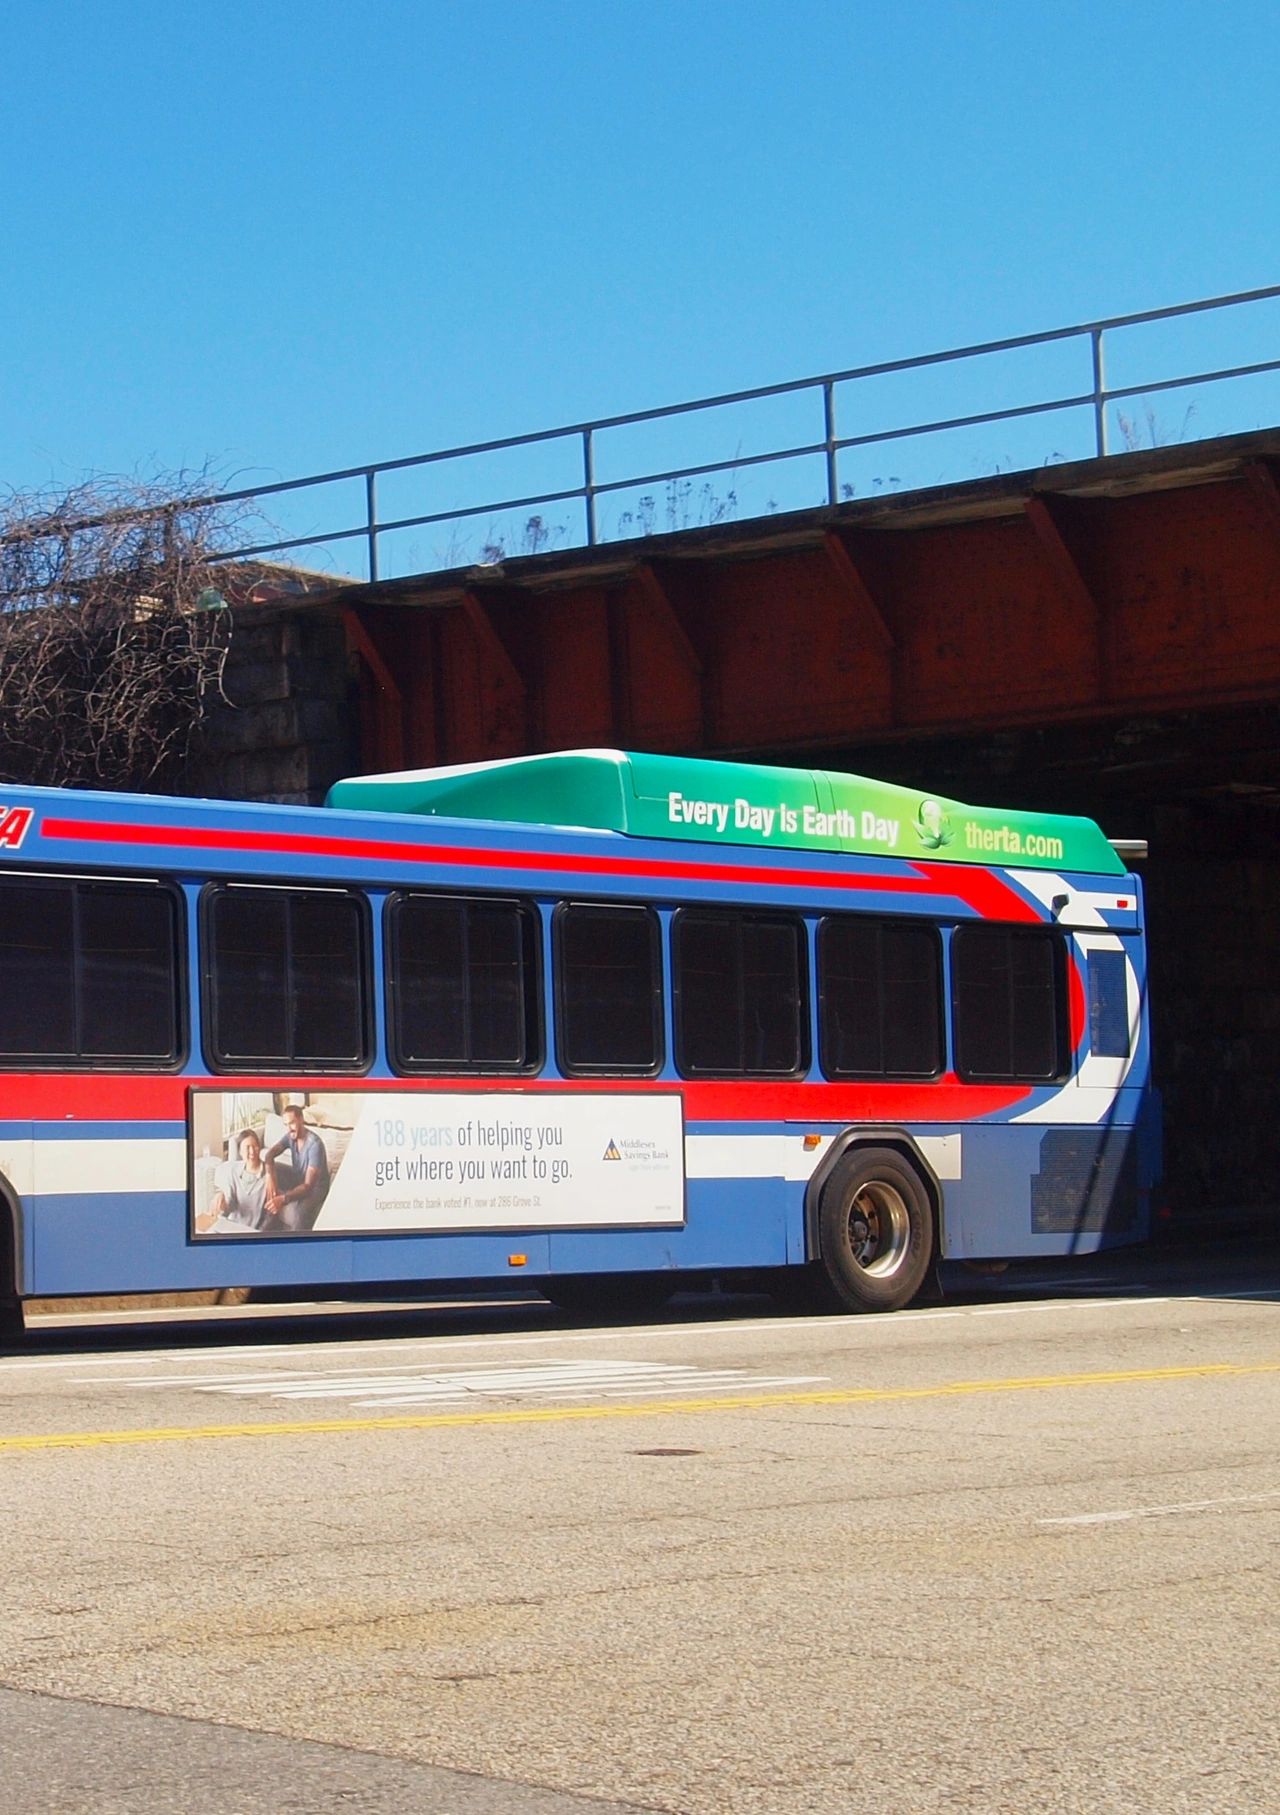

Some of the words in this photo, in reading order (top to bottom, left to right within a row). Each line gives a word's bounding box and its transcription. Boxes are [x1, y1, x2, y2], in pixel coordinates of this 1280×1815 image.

[669, 792, 729, 833] Every
[735, 798, 775, 837] Day
[803, 805, 856, 839] Earth
[861, 810, 899, 847] Day
[964, 822, 1063, 860] therta.com
[374, 1119, 405, 1147] 188
[410, 1126, 453, 1151] years
[458, 1120, 472, 1146] of
[477, 1119, 533, 1152] helping
[537, 1126, 563, 1150] you
[375, 1155, 401, 1187] get
[406, 1153, 454, 1180] where
[459, 1160, 485, 1184] you
[490, 1154, 527, 1180] want
[533, 1154, 547, 1179] to
[551, 1159, 573, 1184] go.
